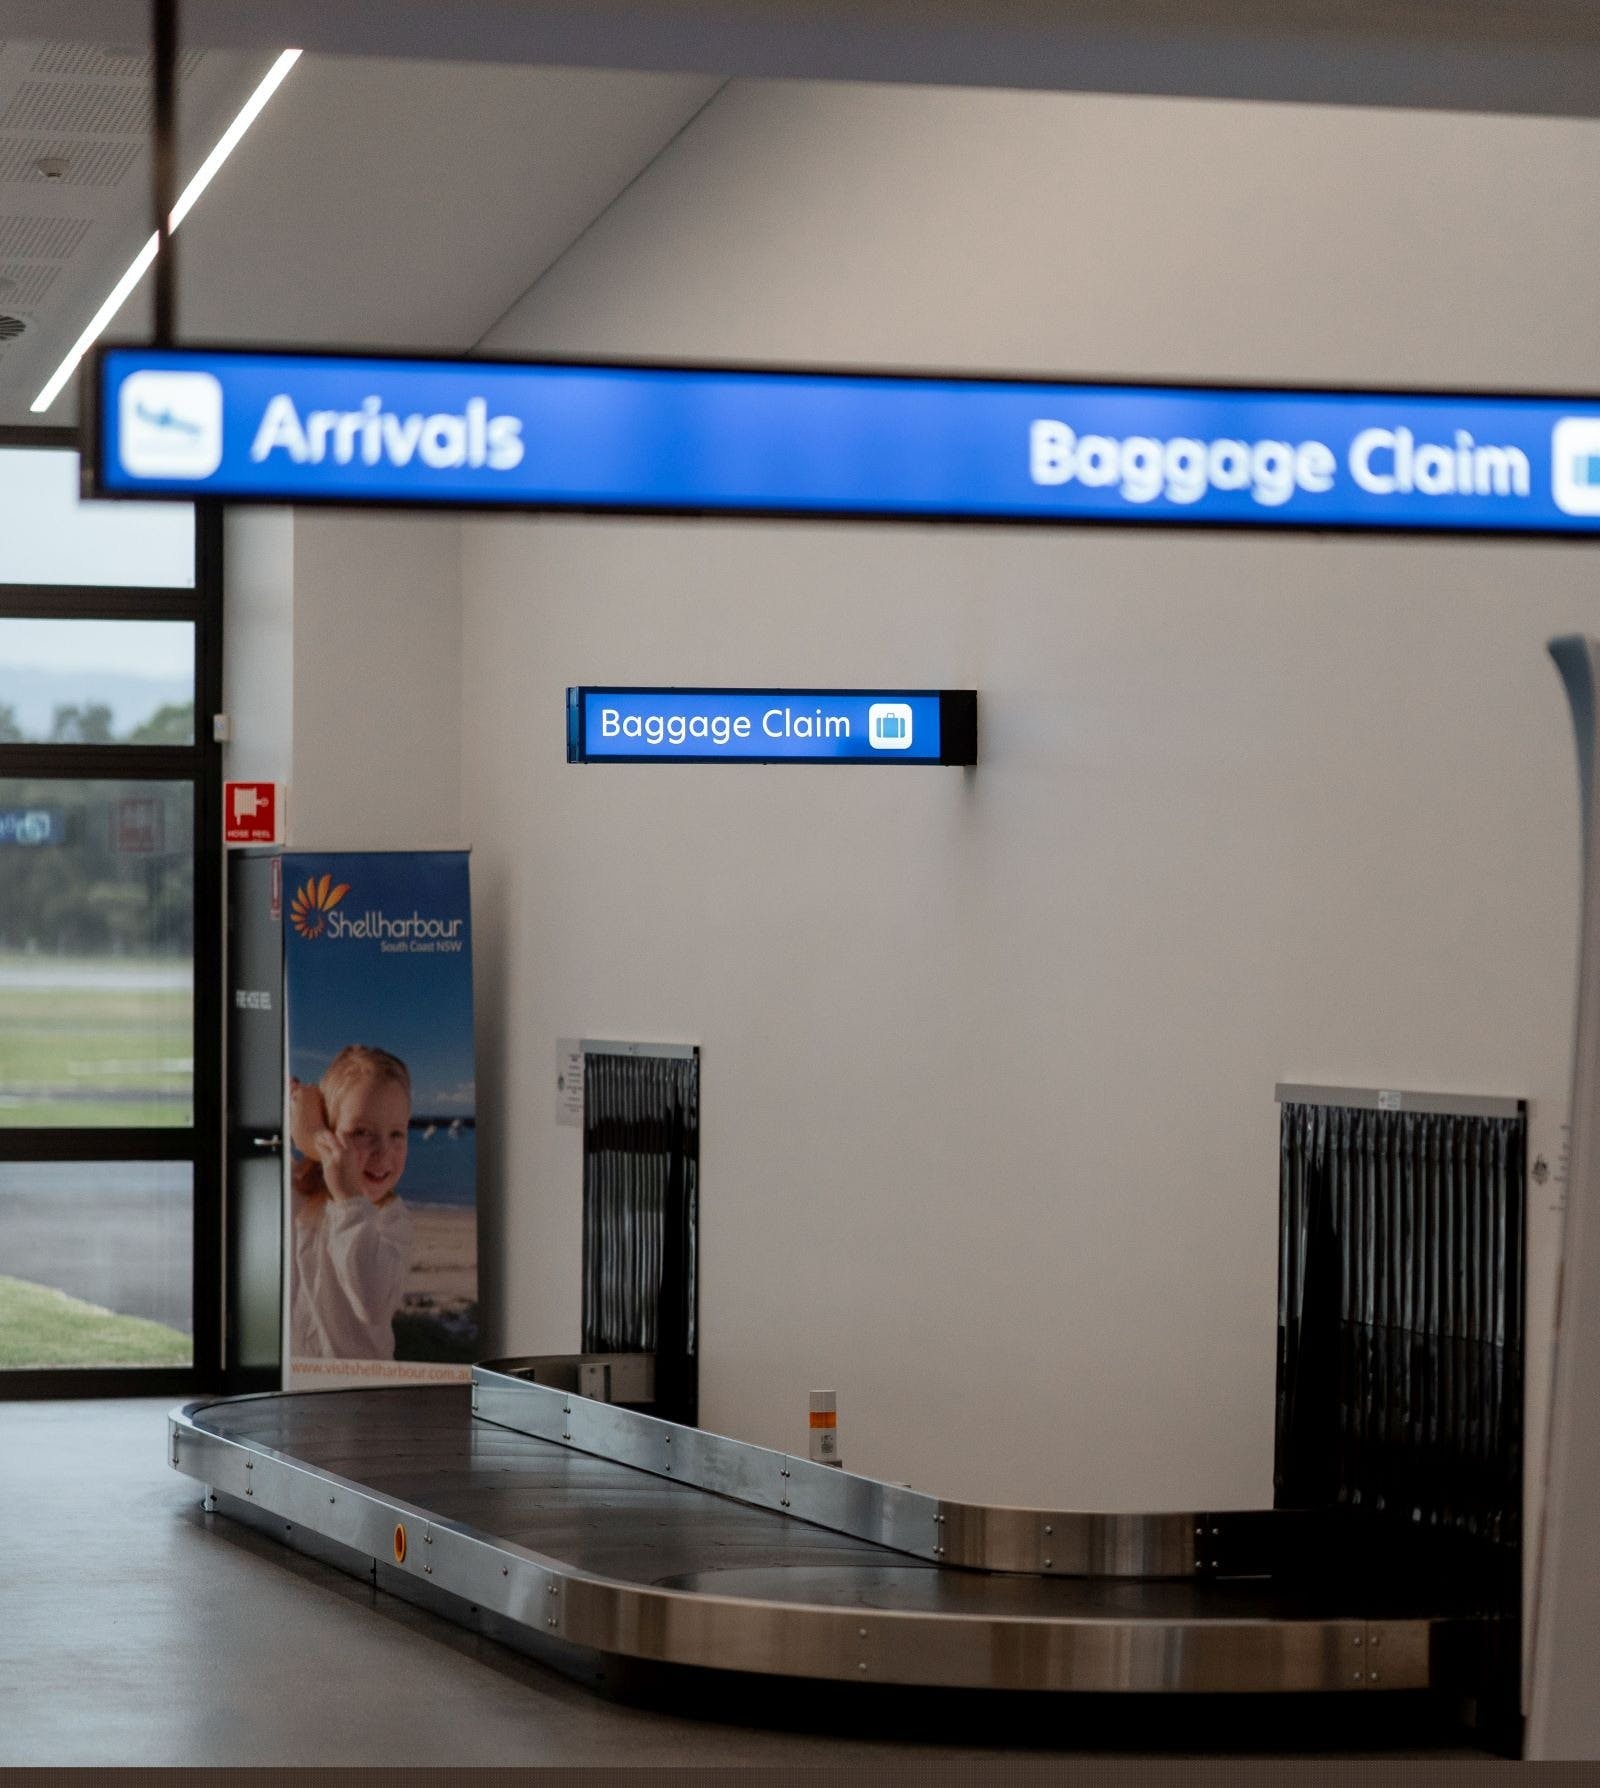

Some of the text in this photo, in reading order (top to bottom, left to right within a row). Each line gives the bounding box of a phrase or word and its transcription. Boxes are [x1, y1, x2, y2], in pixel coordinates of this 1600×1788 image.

[250, 393, 525, 471] Arrivals
[1029, 418, 1531, 507] Baggage Claim
[601, 708, 850, 745] Baggage Claim
[327, 911, 463, 939] Shellharbour
[380, 941, 462, 953] South Coast NSW
